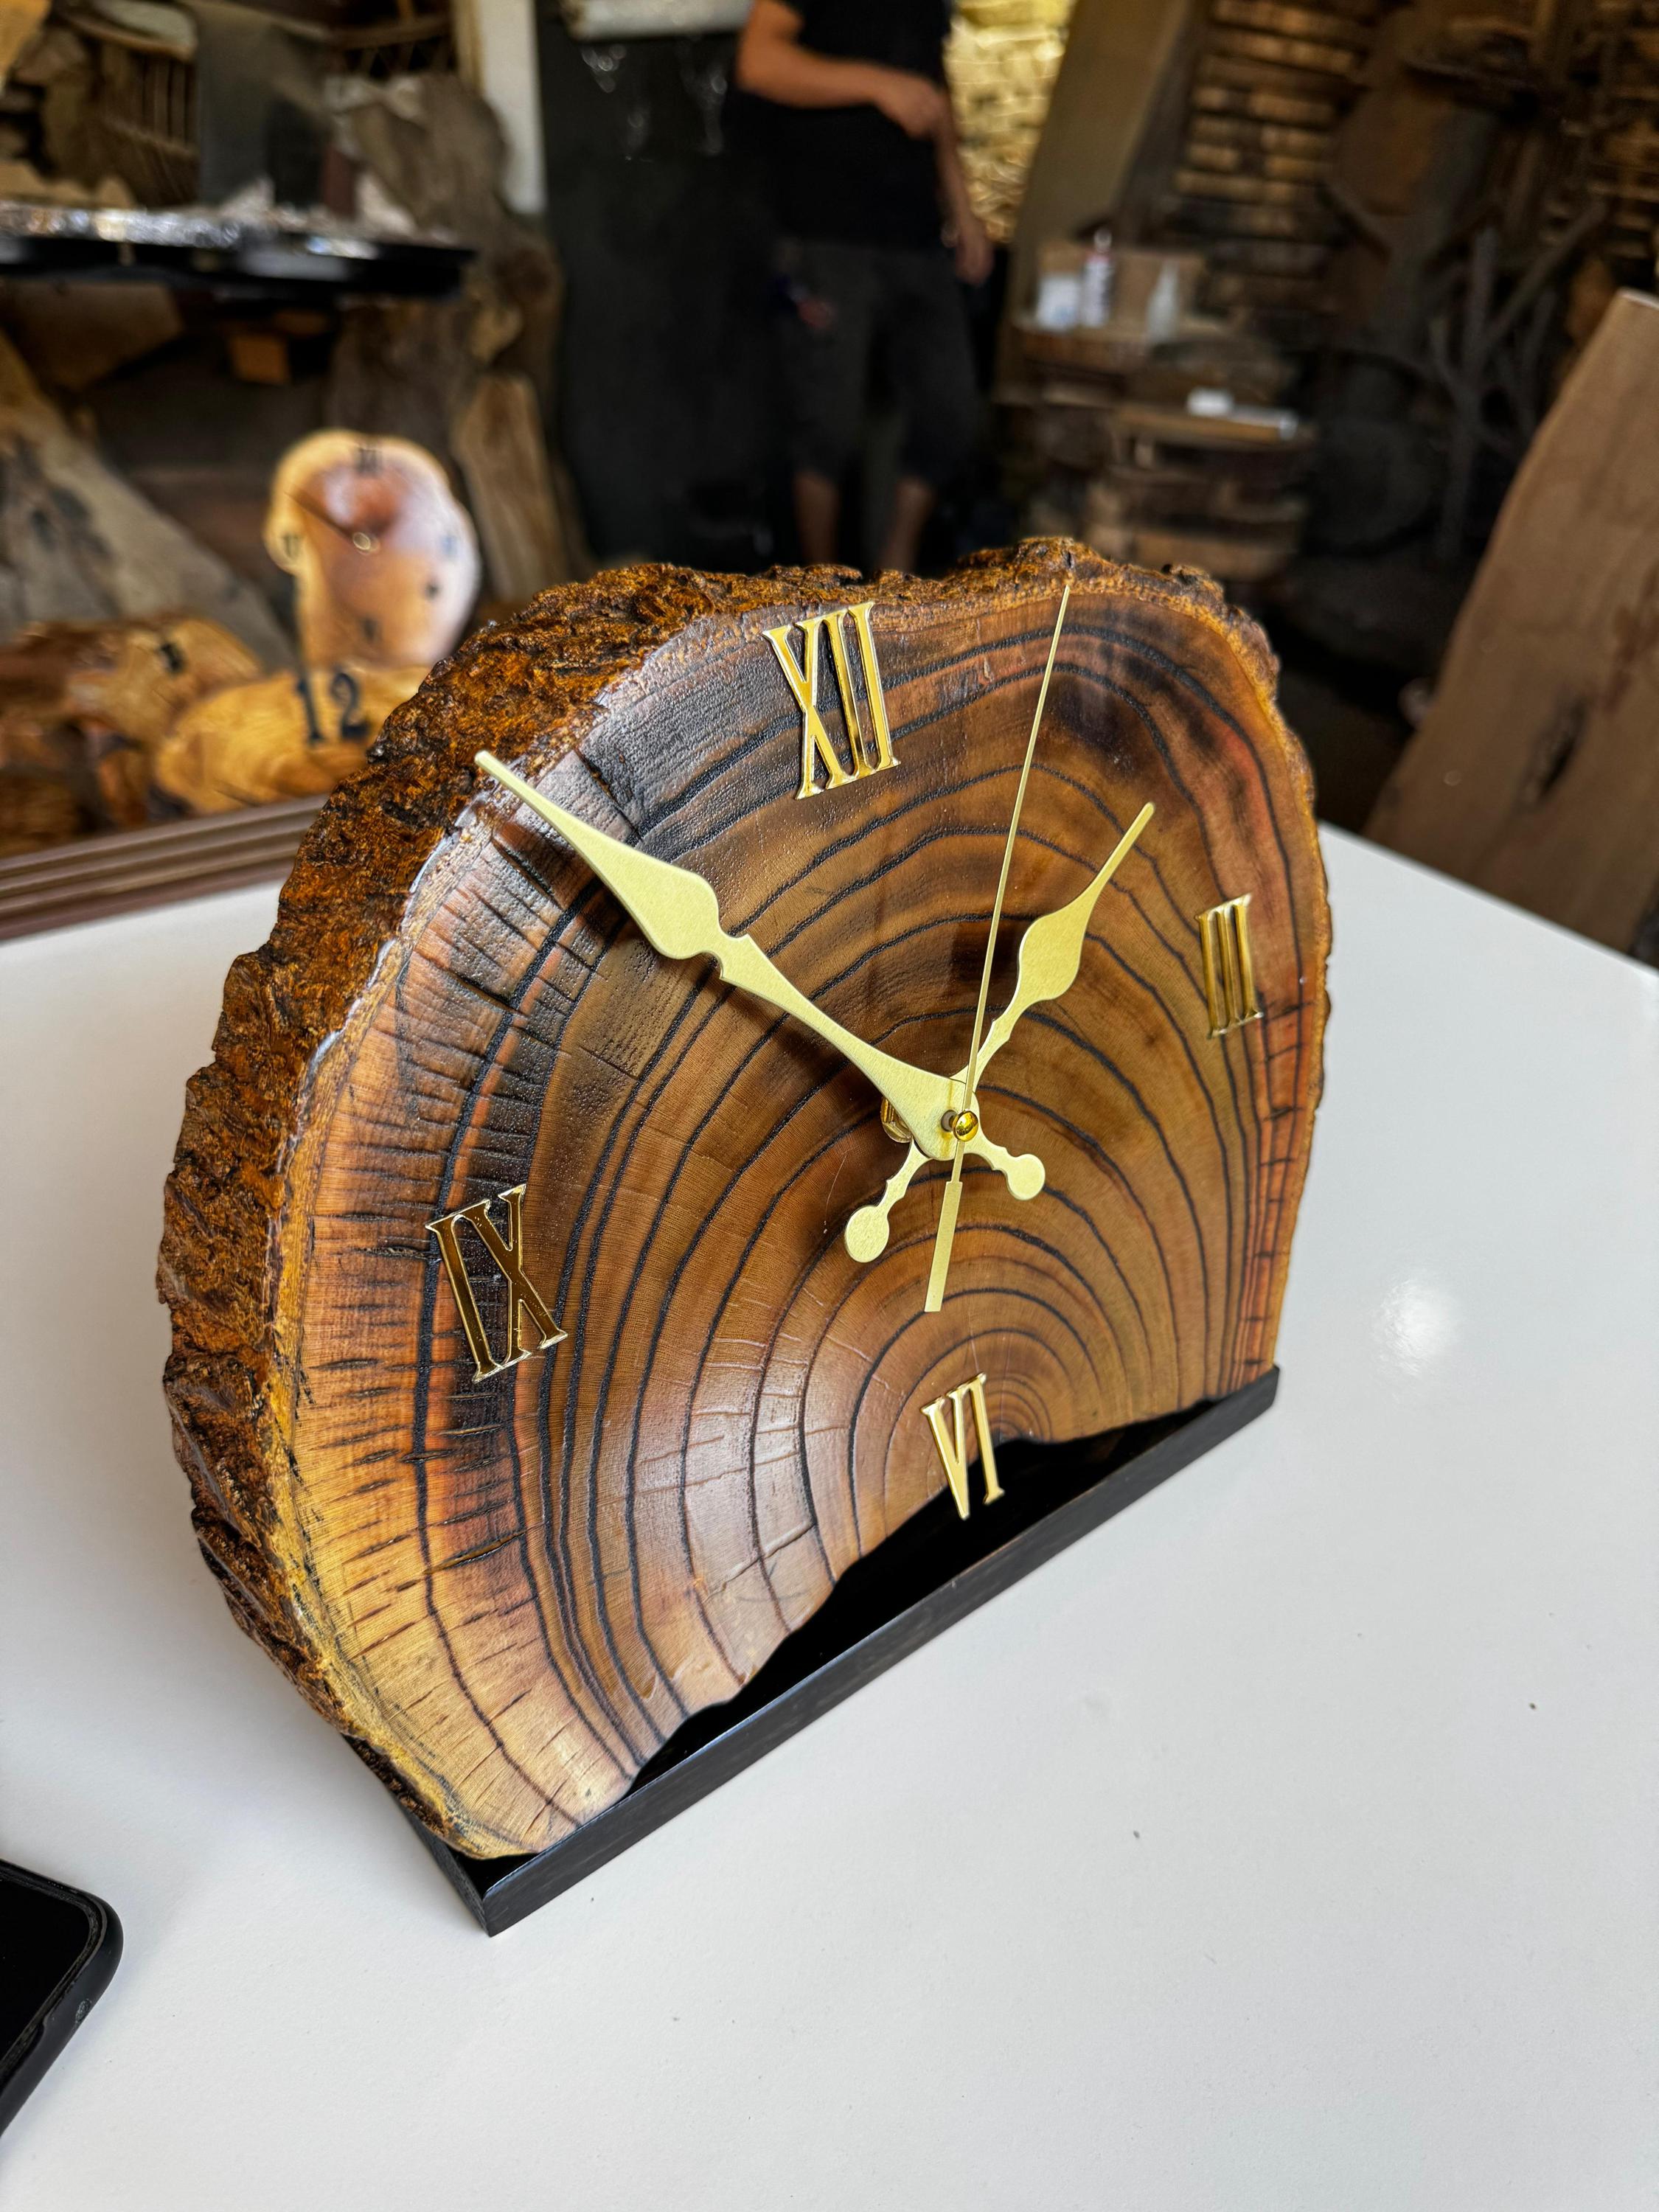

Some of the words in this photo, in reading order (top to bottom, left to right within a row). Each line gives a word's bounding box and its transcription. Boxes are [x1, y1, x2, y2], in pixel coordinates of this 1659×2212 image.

[297, 670, 370, 745] 12
[762, 602, 901, 799] XII
[1194, 893, 1264, 1040] III
[425, 1184, 568, 1383] IX
[921, 1371, 1005, 1520] VI
